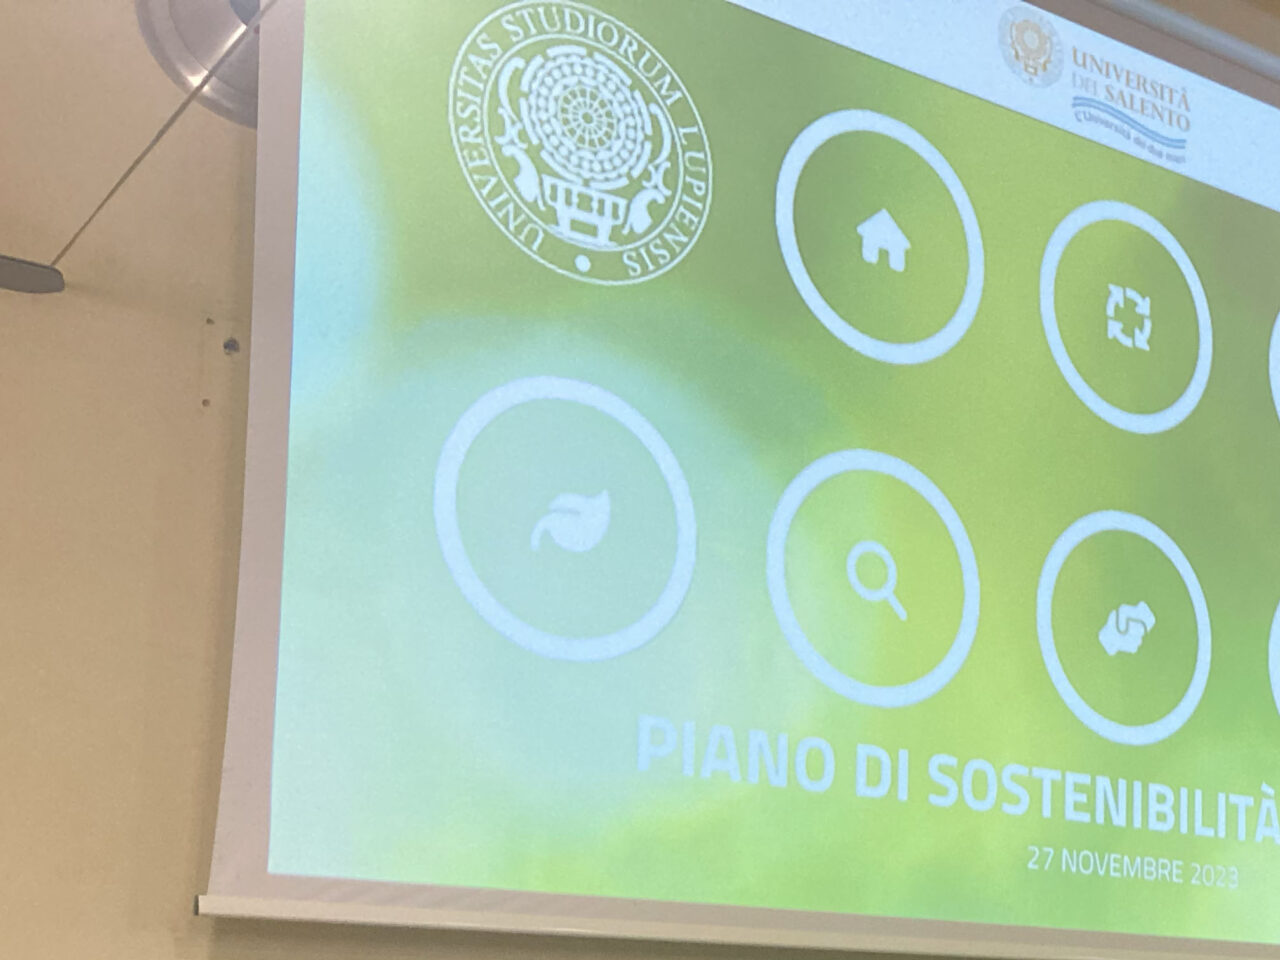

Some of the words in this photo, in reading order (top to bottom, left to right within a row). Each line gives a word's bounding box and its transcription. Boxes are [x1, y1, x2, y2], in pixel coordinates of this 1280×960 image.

[1072, 46, 1191, 112] UNIVERSITÀ
[1104, 84, 1191, 132] SALENTO
[456, 33, 545, 251] UNIVERSITAS
[501, 6, 683, 107] STUDIORUM
[621, 124, 707, 276] LUPIENSIS
[636, 714, 836, 793] PIANO
[855, 743, 909, 802] DI
[1027, 846, 1055, 870] 27
[1062, 851, 1184, 884] NOVEMBRE
[1190, 864, 1240, 890] 2023
